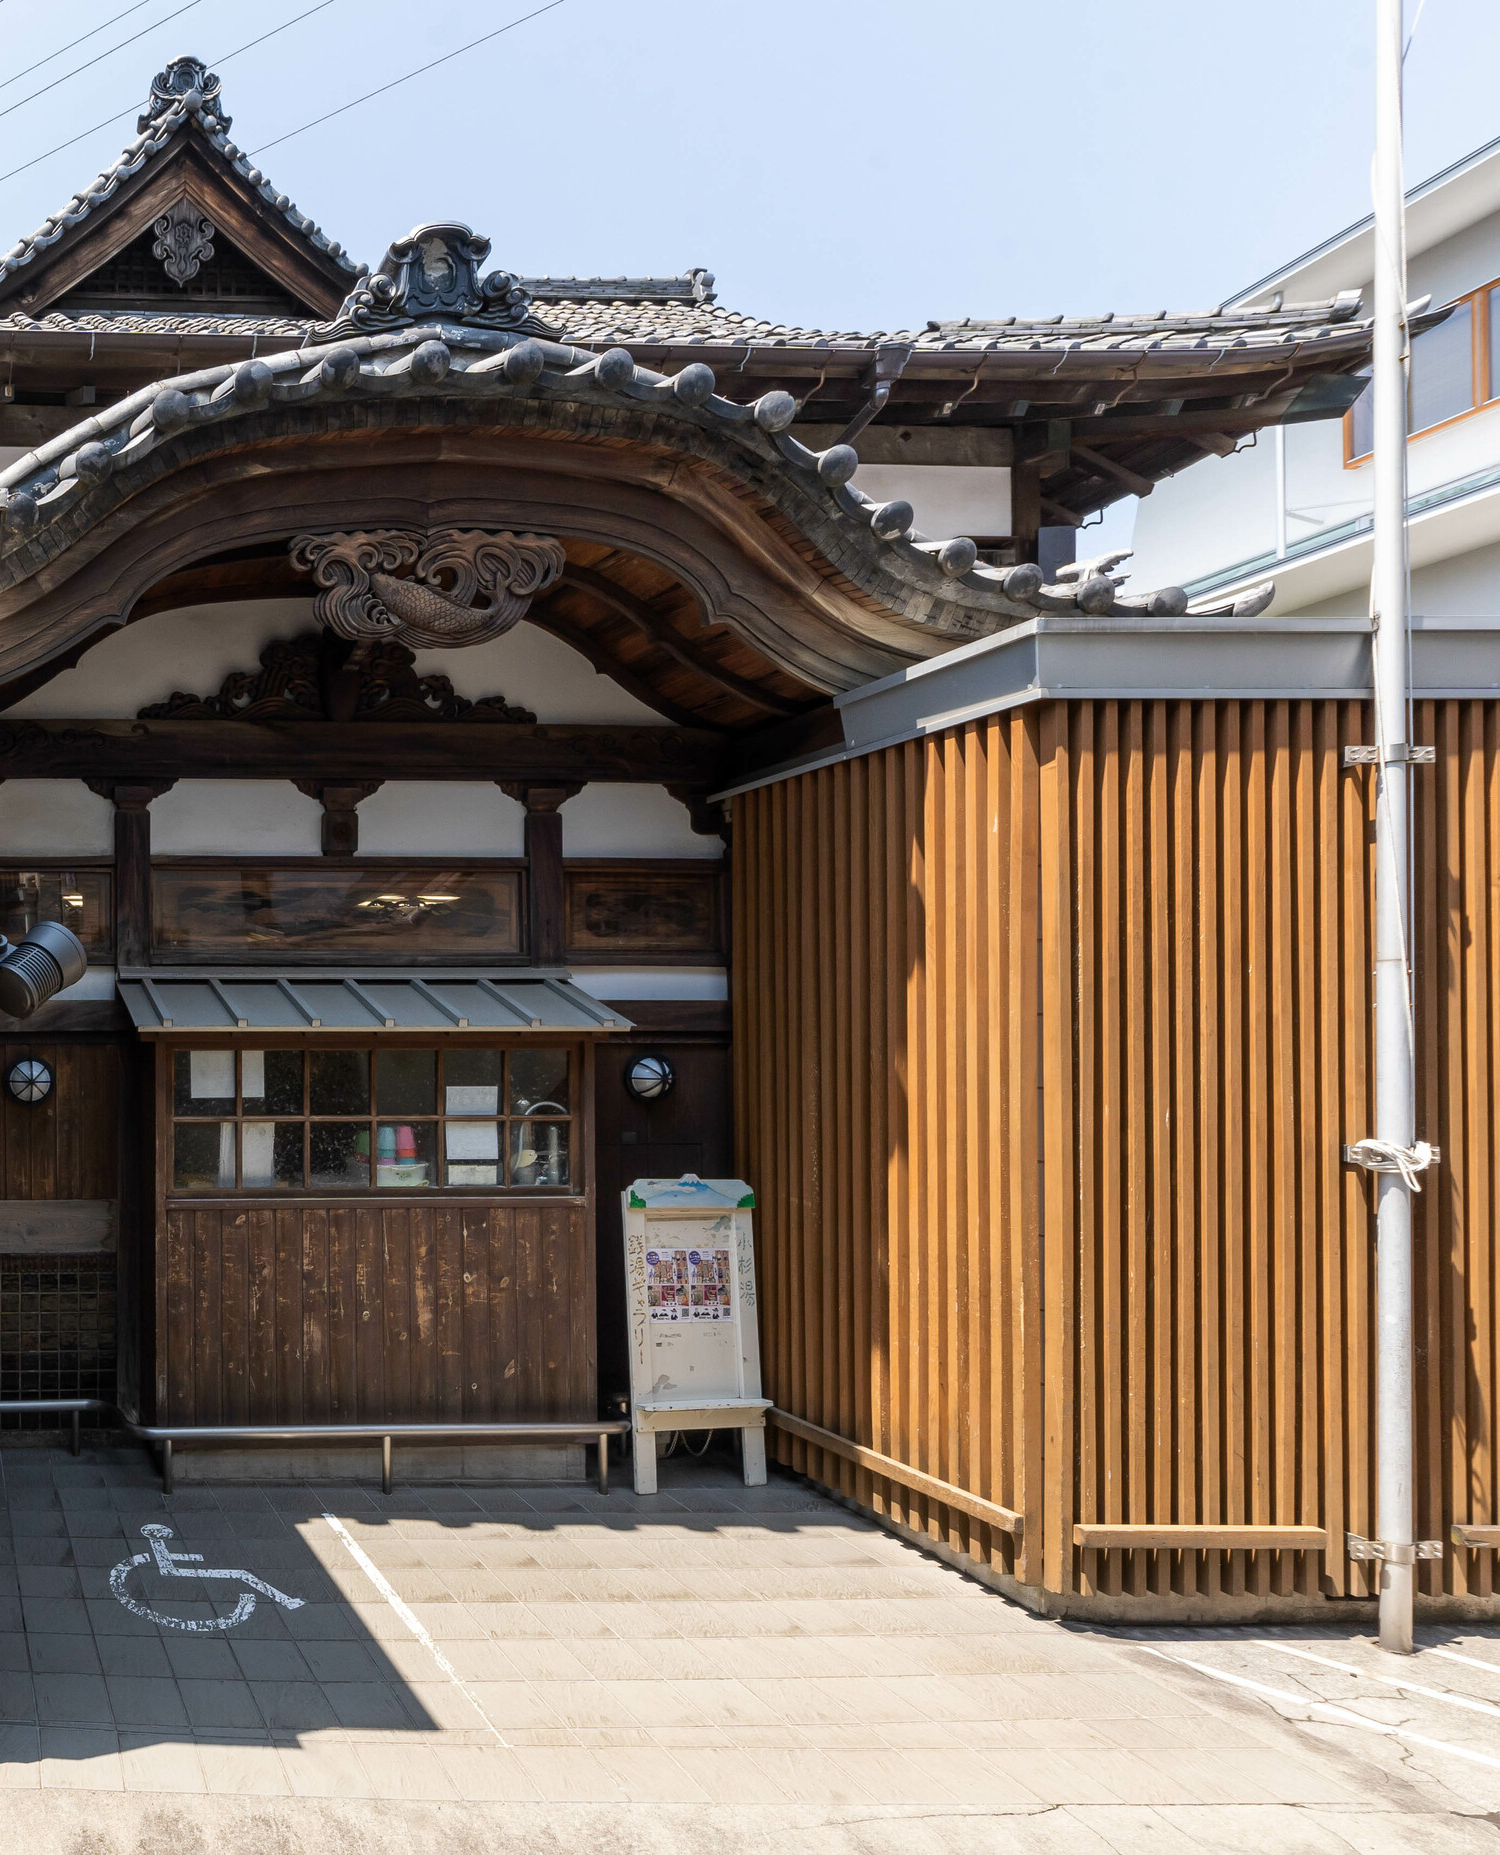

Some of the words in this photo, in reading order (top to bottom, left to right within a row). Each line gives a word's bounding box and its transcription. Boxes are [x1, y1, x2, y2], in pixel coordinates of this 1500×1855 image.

[628, 1234, 647, 1365] 銭湯ギャラリー
[737, 1232, 755, 1307] 小杉湯
